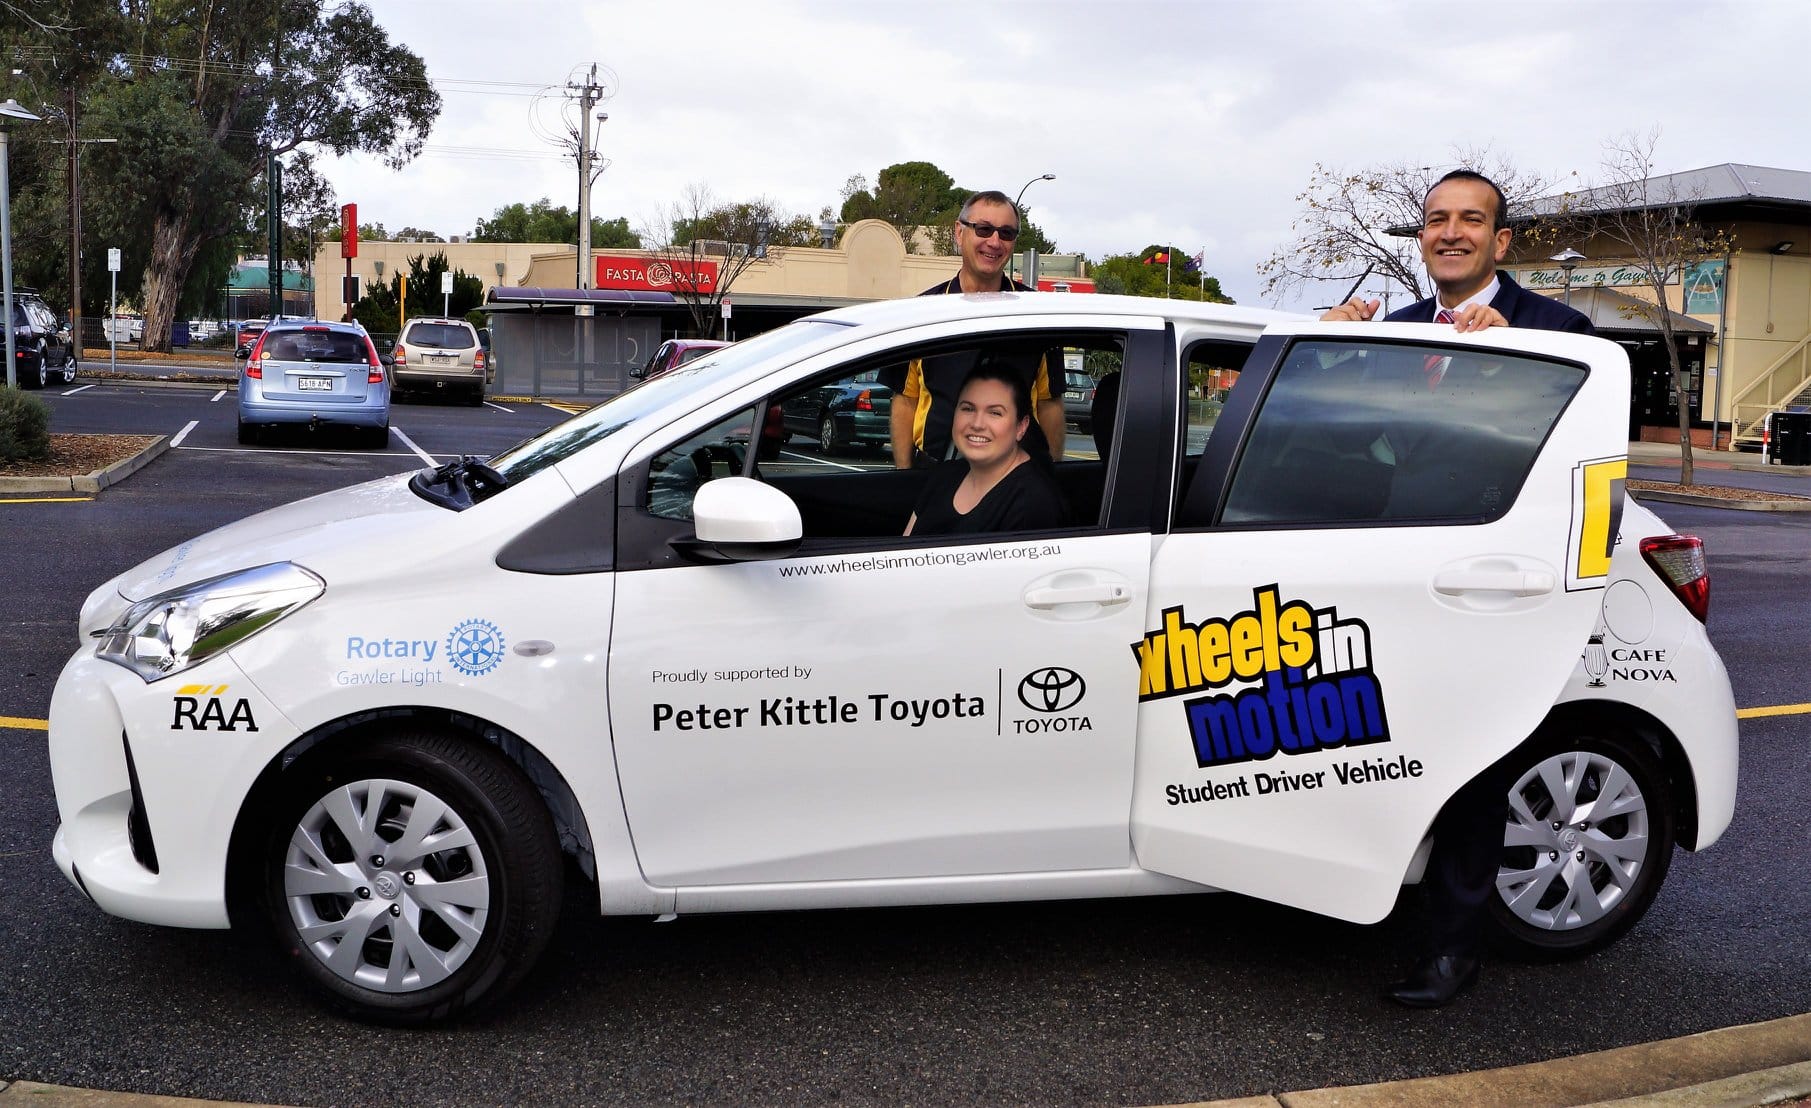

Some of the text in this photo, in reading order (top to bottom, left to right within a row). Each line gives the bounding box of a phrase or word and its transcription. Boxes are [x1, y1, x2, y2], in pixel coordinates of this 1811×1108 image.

[606, 268, 645, 281] FASTA
[1593, 271, 1606, 282] to
[779, 544, 1061, 577] www.wheelsinmotiongawler.org.au
[347, 637, 437, 662] Rotary
[1132, 584, 1370, 699] wheels in
[337, 668, 442, 686] Gawler Light
[652, 665, 812, 683] Proudly supported by
[1612, 667, 1677, 683] NOVA
[171, 696, 259, 732] RAA
[653, 693, 985, 731] Peter Kittle Toyota
[1188, 668, 1386, 765] motion
[1013, 716, 1093, 734] TOYOTA
[1165, 755, 1424, 806] Student Driver Vehicle
